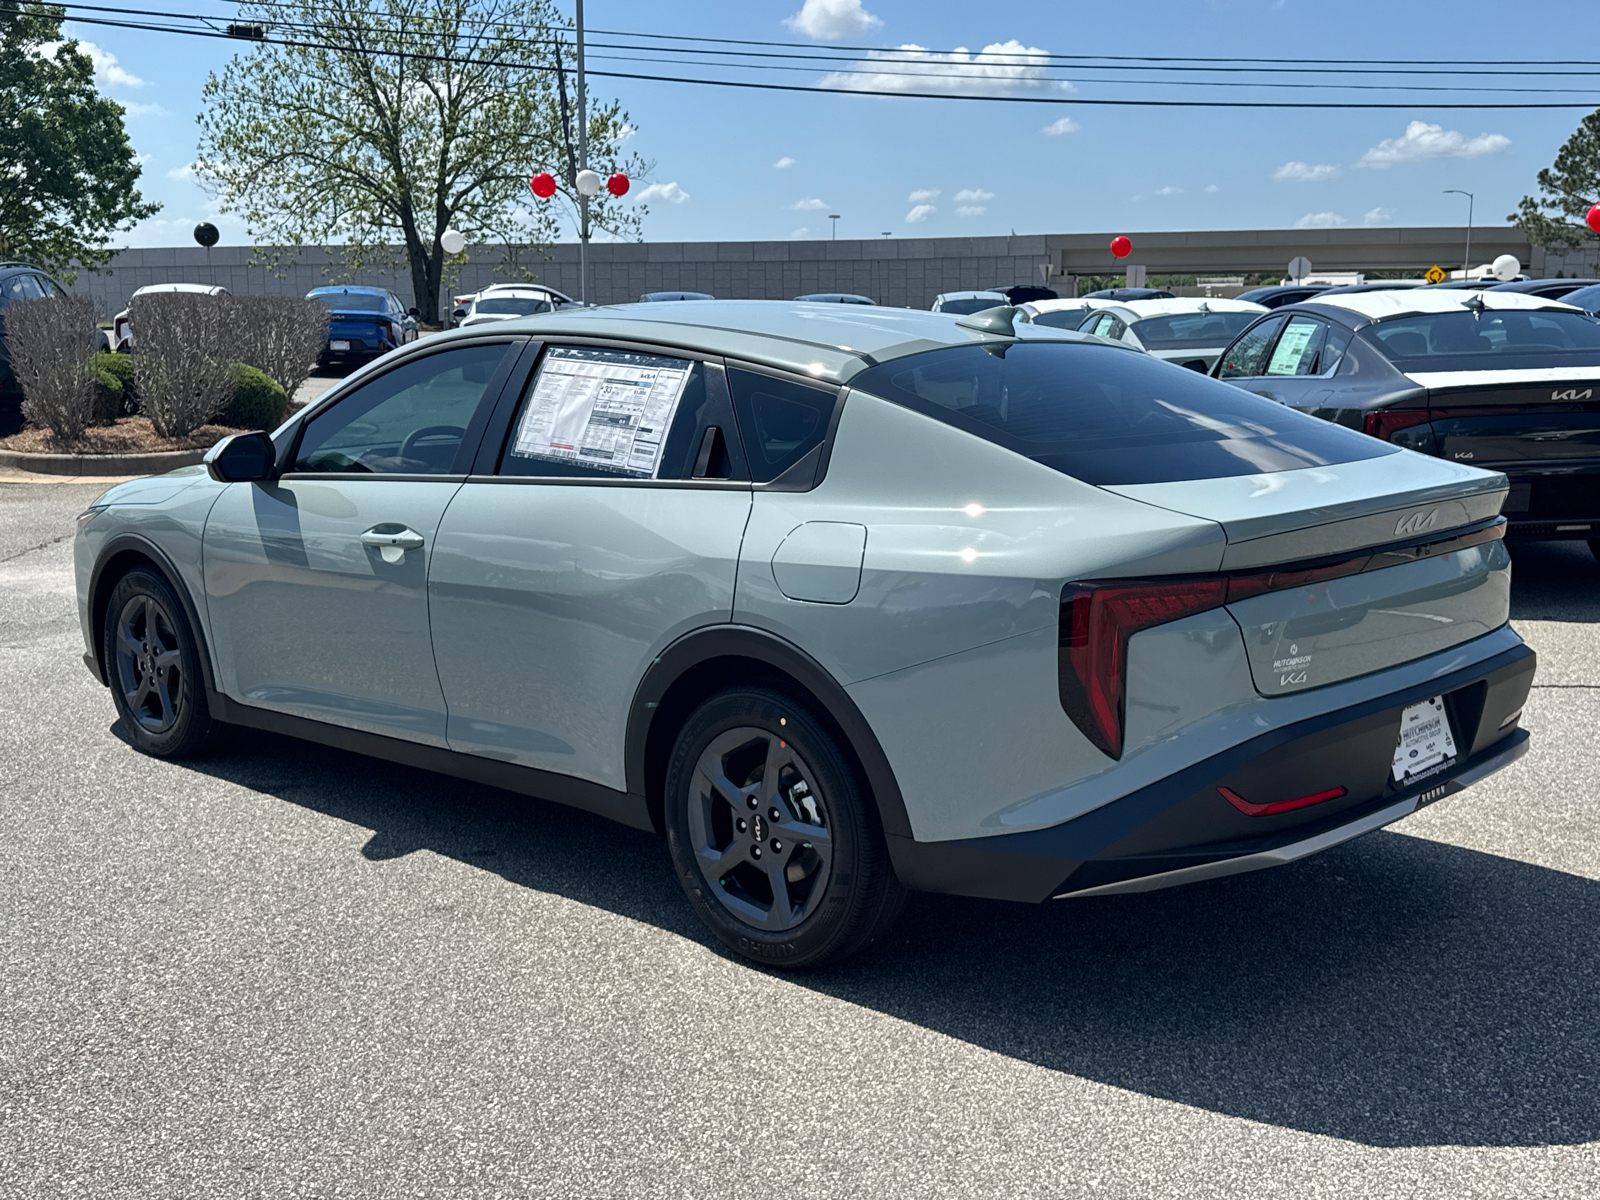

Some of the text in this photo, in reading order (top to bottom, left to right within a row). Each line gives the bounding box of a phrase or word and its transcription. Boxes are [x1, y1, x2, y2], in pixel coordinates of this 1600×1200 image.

[1551, 388, 1593, 400] KIA
[1454, 451, 1474, 459] K4
[1393, 507, 1438, 536] KIA
[1273, 655, 1311, 668] HUTCHINSON
[1280, 670, 1307, 686] K4
[1402, 716, 1441, 742] HUTCHINSON
[668, 731, 697, 798] SOLUS
[754, 815, 762, 842] KIA
[738, 936, 798, 959] KUMHO
